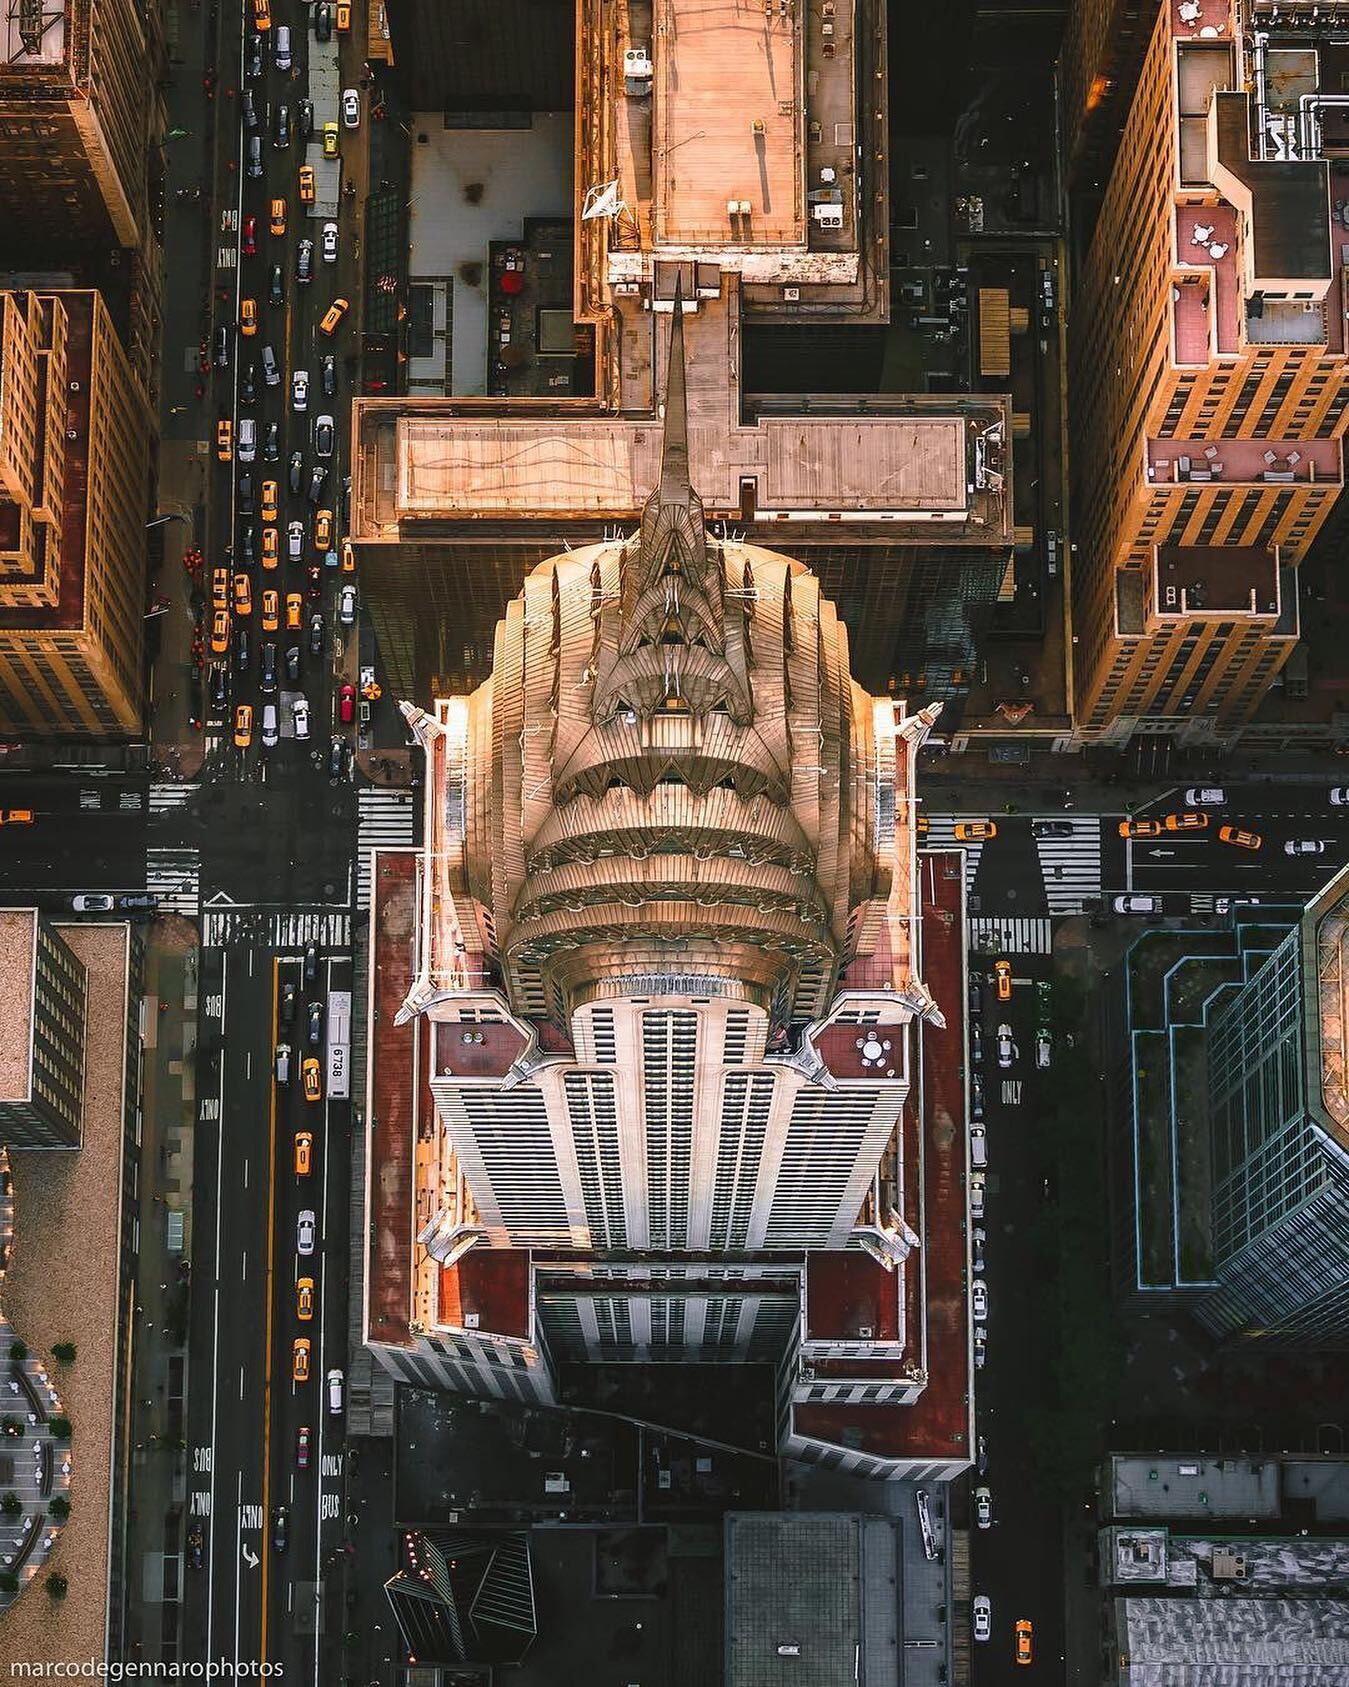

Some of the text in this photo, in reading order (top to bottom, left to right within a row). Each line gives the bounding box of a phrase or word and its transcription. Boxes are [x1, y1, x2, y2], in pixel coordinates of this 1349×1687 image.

[216, 248, 237, 268] ONLY
[120, 792, 141, 809] BUS
[205, 995, 221, 1017] BUS
[332, 1049, 343, 1077] 6738
[1001, 1080, 1022, 1104] ONLY
[199, 1098, 219, 1120] ONLY
[193, 1447, 212, 1472] BUS
[322, 1454, 343, 1476] ONLY
[189, 1492, 211, 1516] ONLY
[321, 1494, 340, 1520] BUS
[241, 1505, 263, 1528] ONLY
